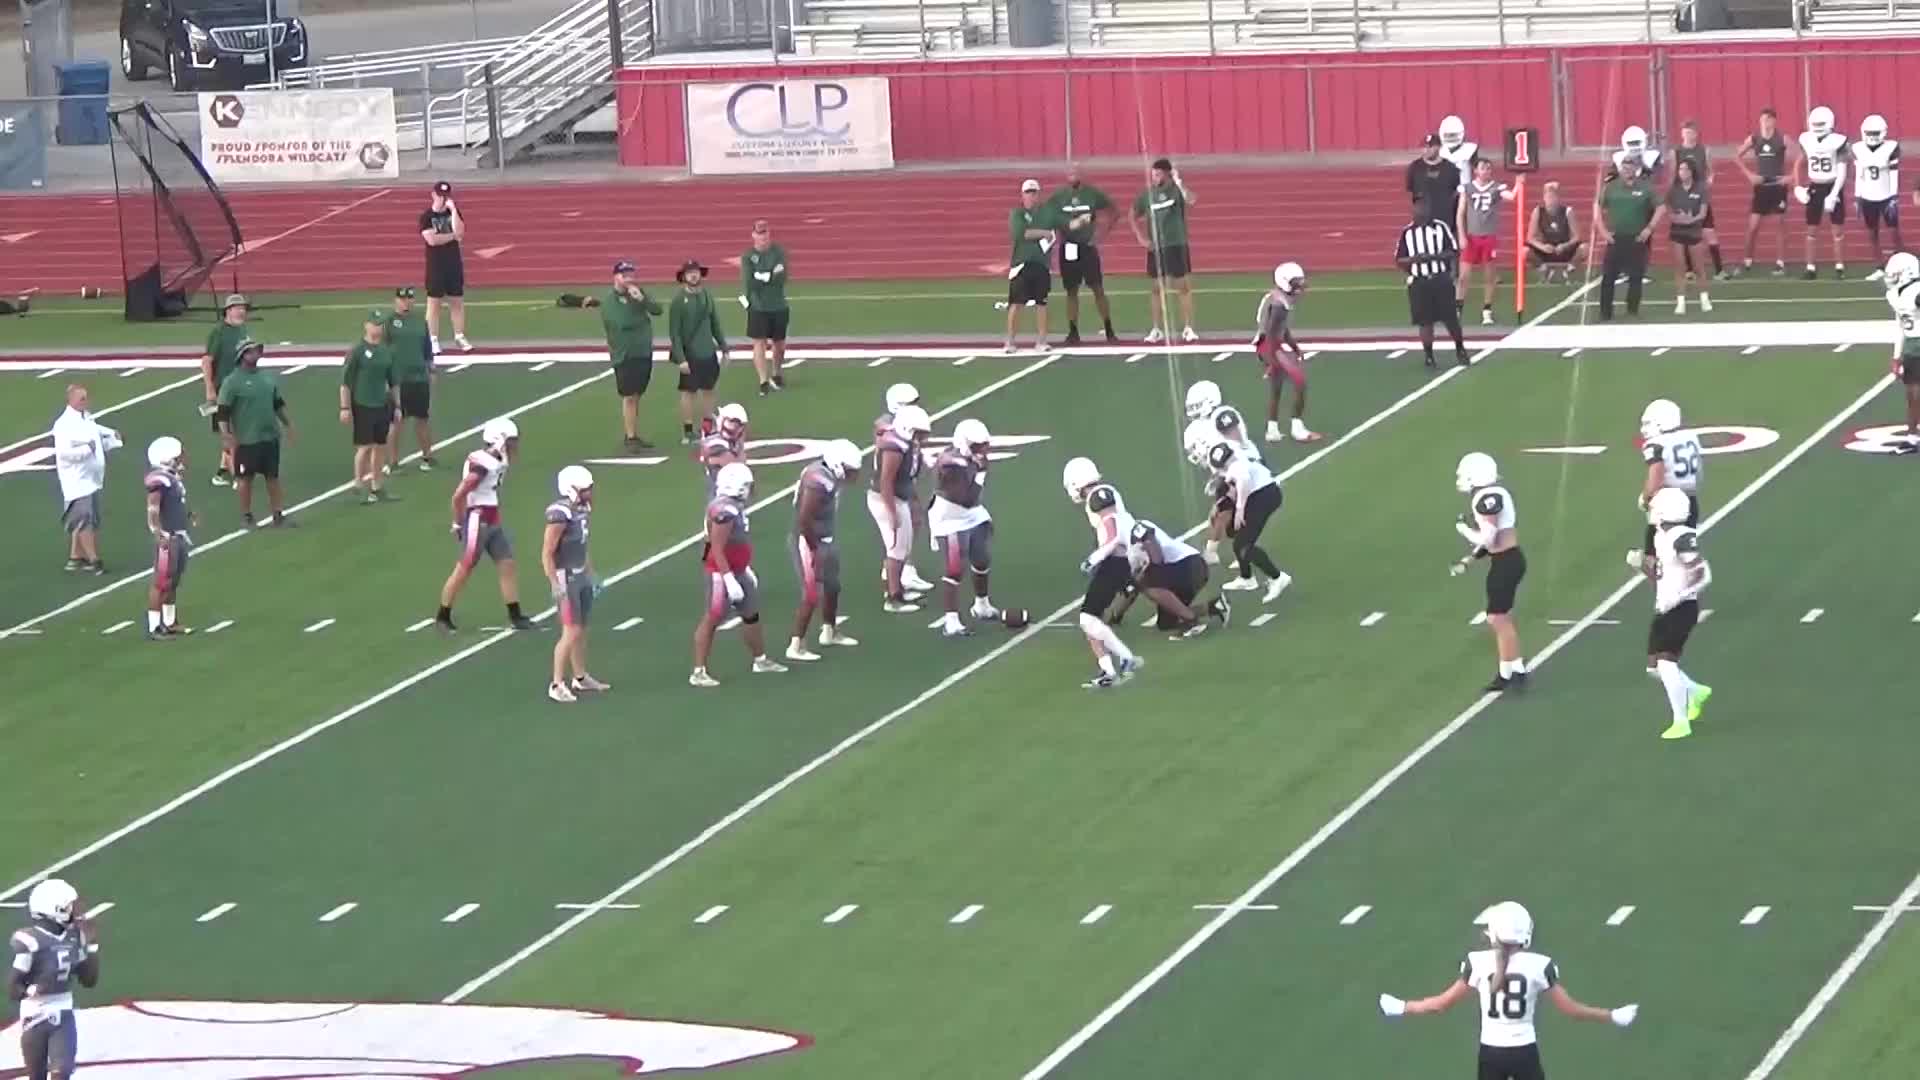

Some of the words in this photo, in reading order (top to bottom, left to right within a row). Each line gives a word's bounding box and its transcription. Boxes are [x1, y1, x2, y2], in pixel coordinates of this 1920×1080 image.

[727, 83, 851, 137] CLP
[211, 142, 251, 153] PROUD
[254, 142, 308, 153] SPONSOR
[216, 153, 285, 165] SPLENDORA
[288, 152, 348, 163] WILDCATS
[1514, 131, 1529, 165] 1
[1672, 440, 1699, 478] 52
[56, 949, 71, 982] 5
[1487, 972, 1528, 1020] 18
